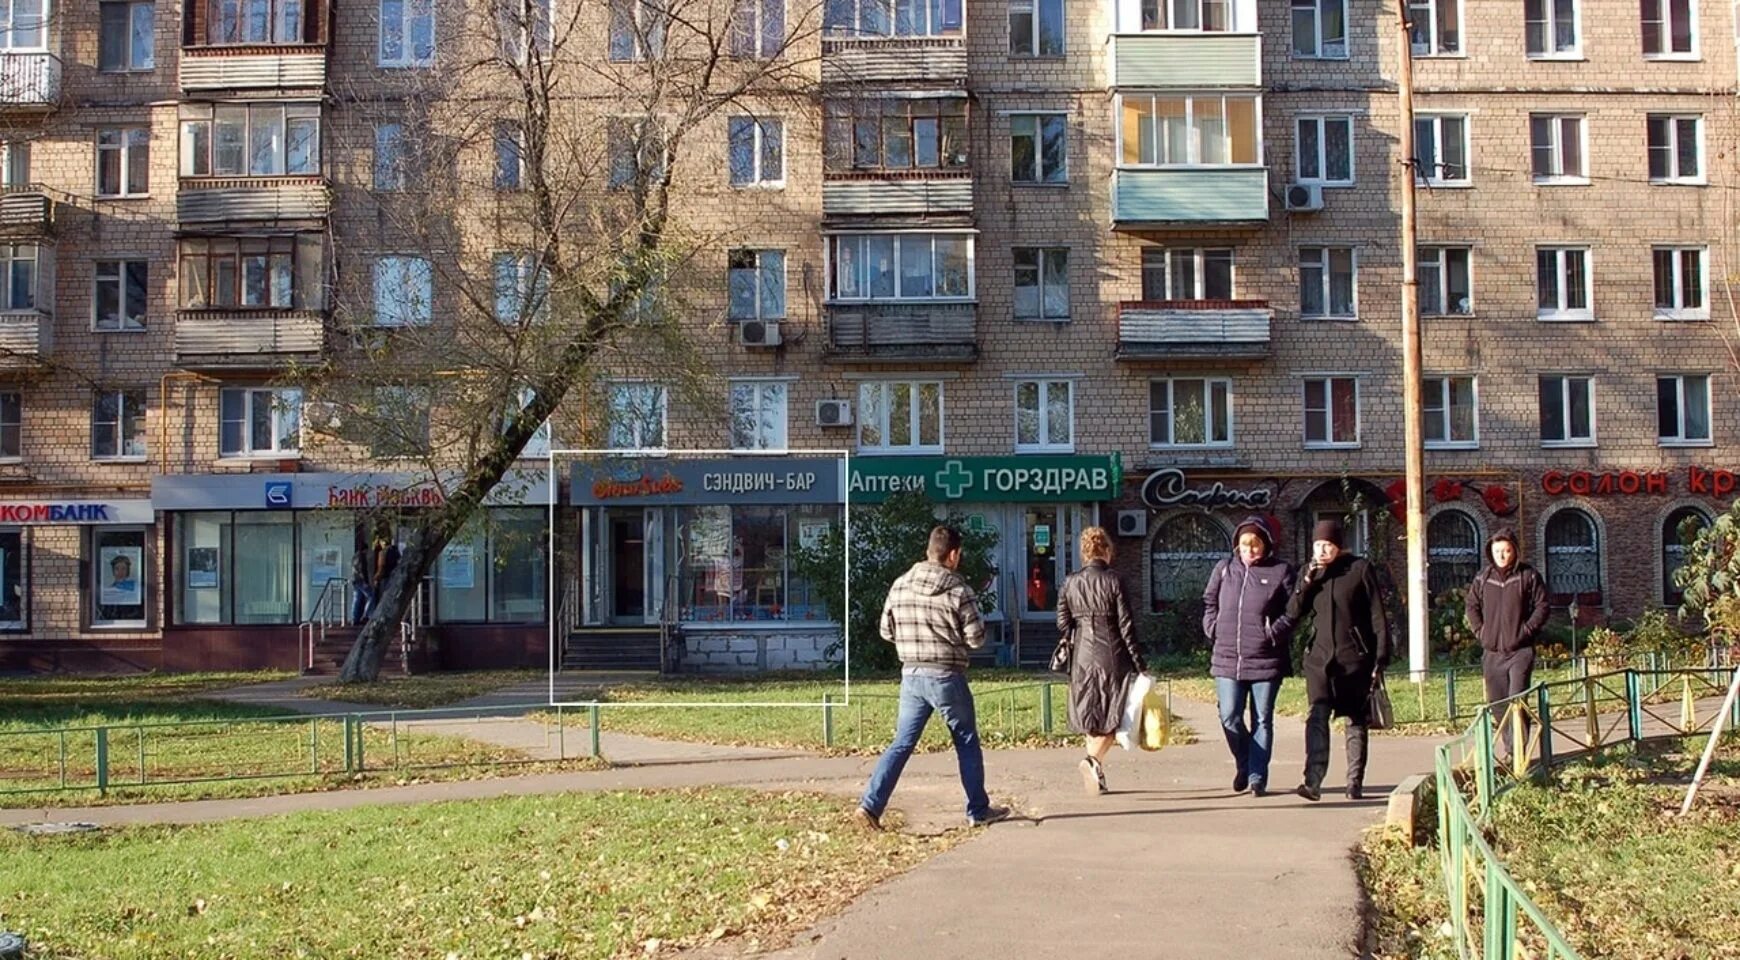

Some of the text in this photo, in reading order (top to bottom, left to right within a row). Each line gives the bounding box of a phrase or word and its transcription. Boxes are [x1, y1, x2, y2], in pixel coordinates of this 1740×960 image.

[703, 472, 816, 494] СЭНДВИЧ-БАР
[849, 467, 1108, 494] Аптеки ГОРЗДРАВ
[1542, 465, 1736, 499] салон кр
[327, 485, 369, 507] Банк
